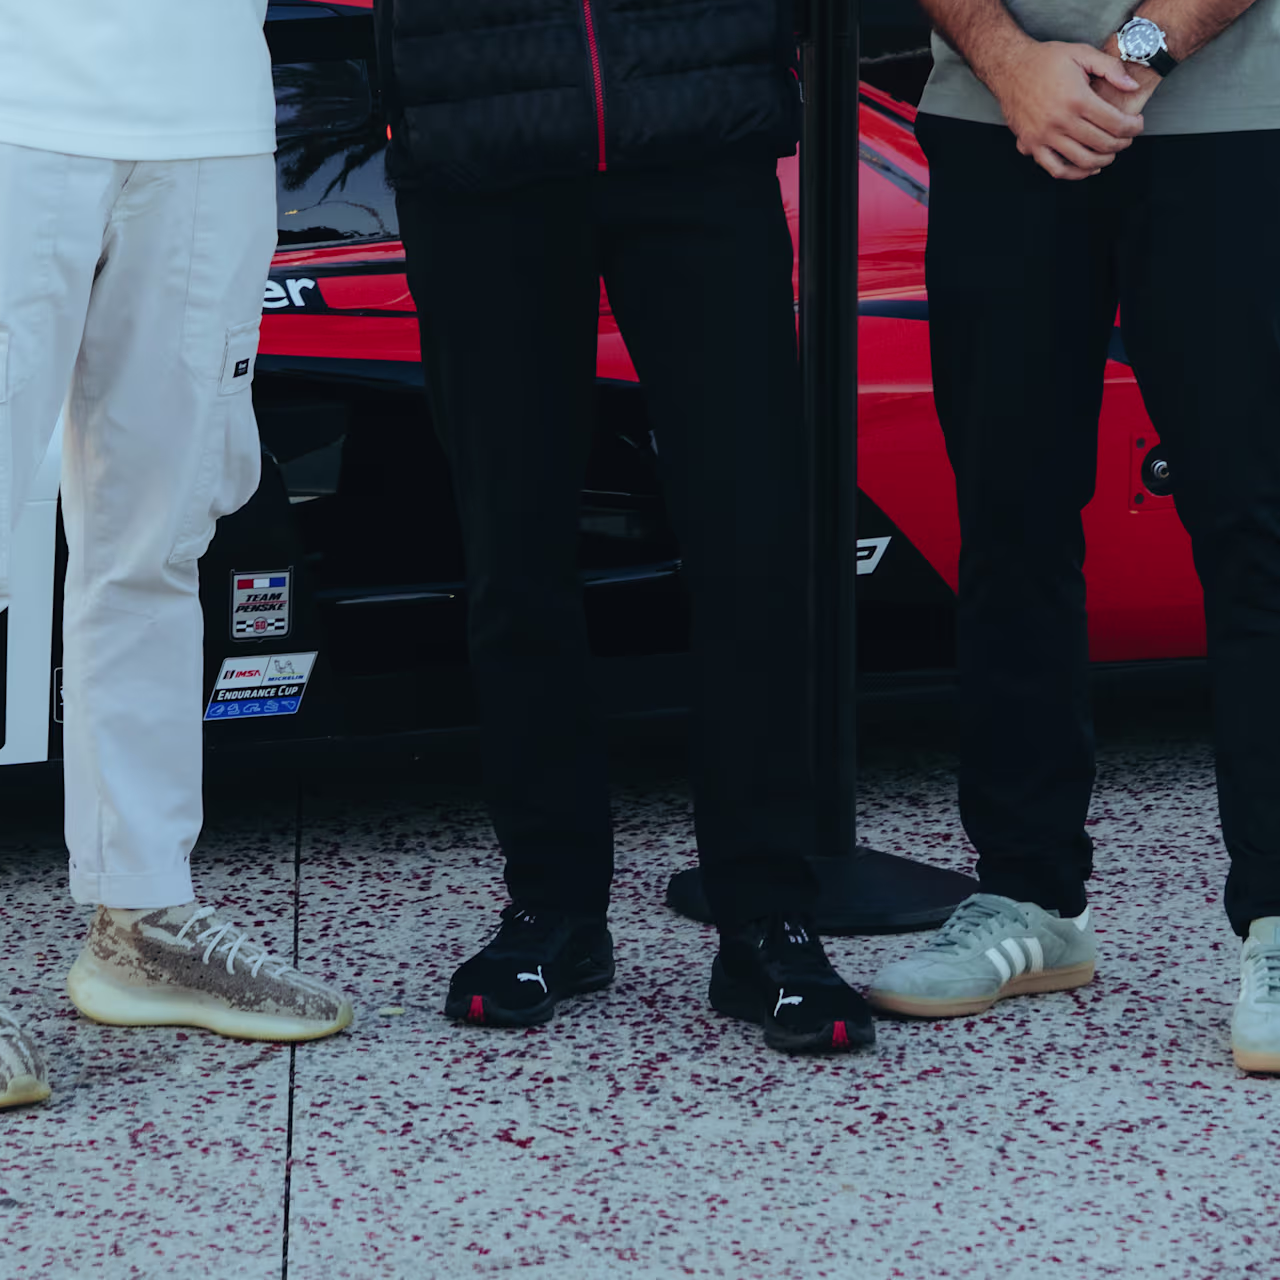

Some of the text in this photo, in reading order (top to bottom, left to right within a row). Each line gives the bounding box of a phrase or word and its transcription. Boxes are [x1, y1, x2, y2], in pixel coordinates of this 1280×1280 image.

[246, 592, 284, 602] TEAM
[235, 602, 286, 613] PENSKE
[234, 670, 261, 678] IMSA
[267, 674, 305, 682] MICHELIN
[217, 685, 299, 701] ENDURANCE CUP
